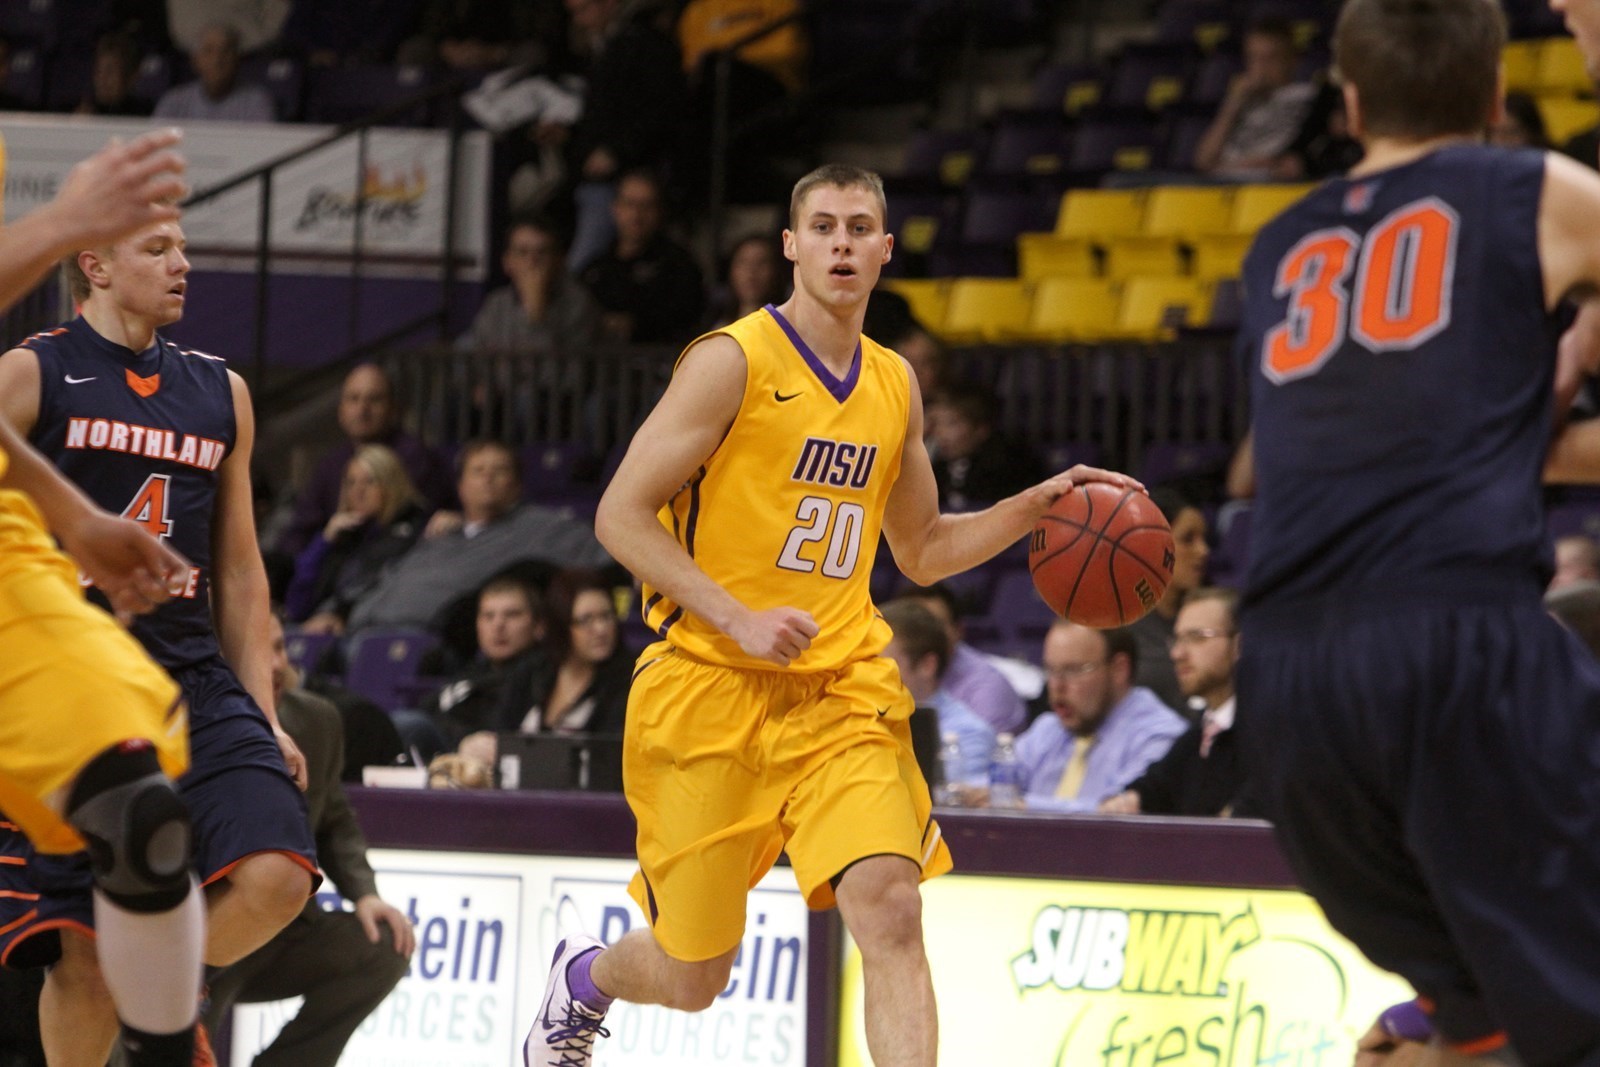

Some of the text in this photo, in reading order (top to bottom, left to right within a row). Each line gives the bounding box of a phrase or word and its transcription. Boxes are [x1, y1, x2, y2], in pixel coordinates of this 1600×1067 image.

[1261, 195, 1460, 386] 30
[65, 416, 225, 471] NORTHLAND
[791, 437, 878, 489] MSU
[119, 472, 174, 546] 4
[778, 495, 865, 580] 20
[403, 897, 504, 982] tein
[1010, 900, 1261, 998] SUBWAY
[1102, 981, 1266, 1067] fresh
